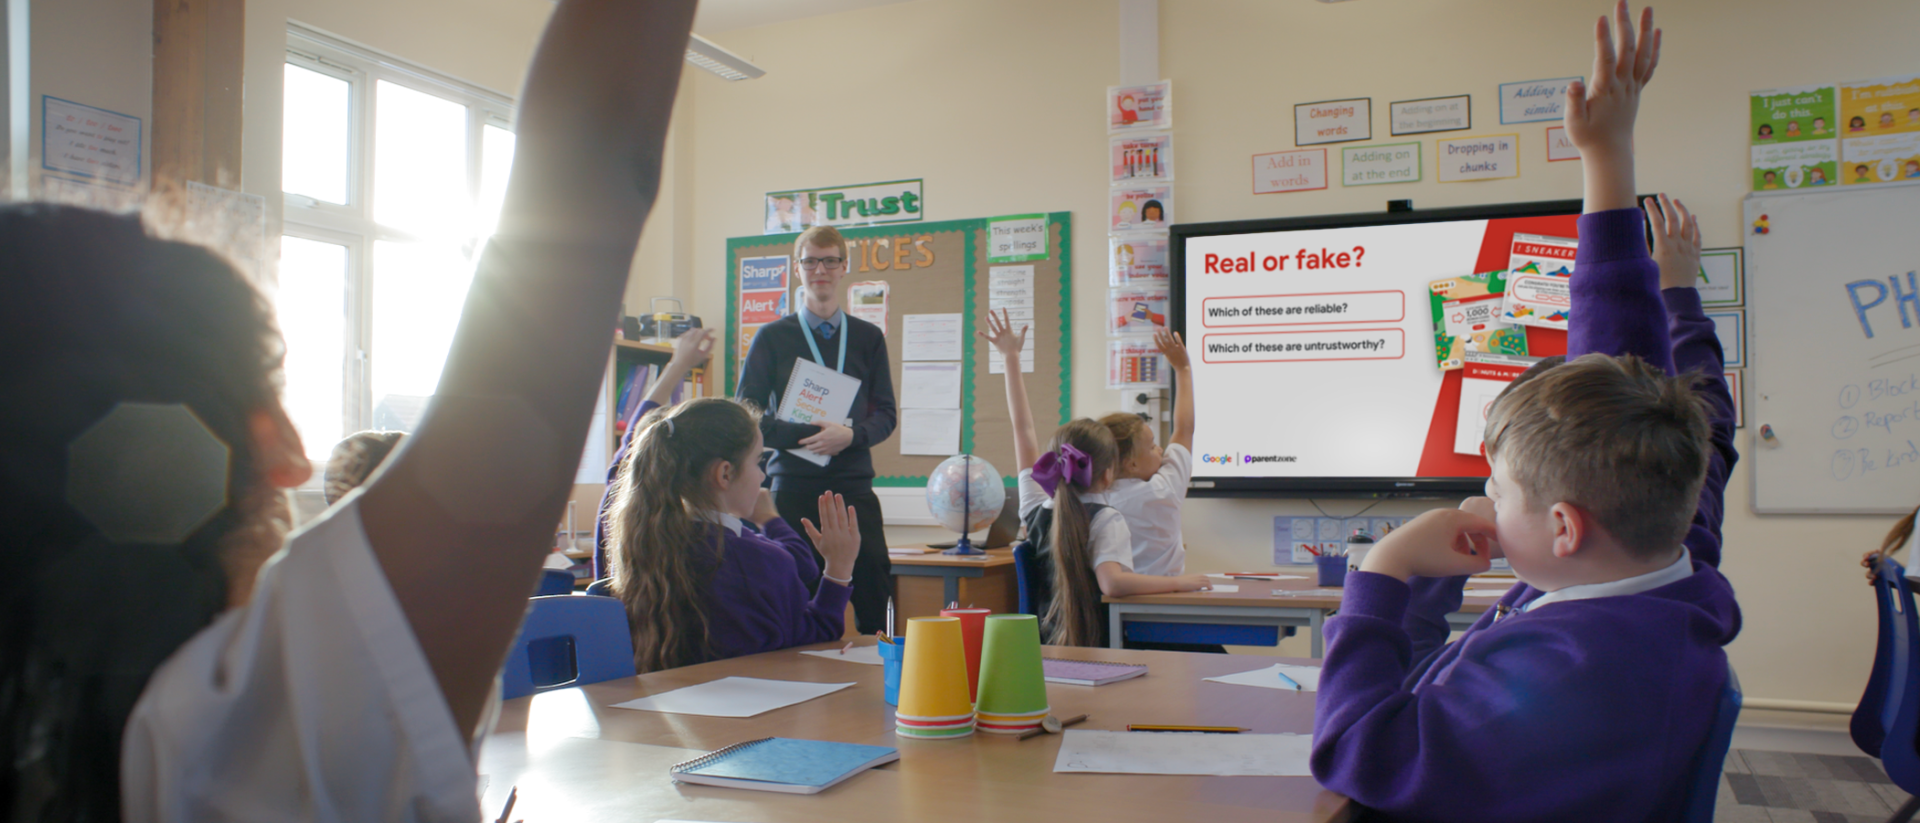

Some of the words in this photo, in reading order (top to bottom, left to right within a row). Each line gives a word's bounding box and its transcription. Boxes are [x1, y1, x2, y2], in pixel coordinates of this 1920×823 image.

[1514, 85, 1556, 99] Adding
[1763, 98, 1768, 108] I
[1771, 98, 1791, 110] just
[1795, 94, 1822, 105] can't
[1310, 105, 1354, 119] Changing
[1401, 105, 1433, 115] Adding
[1524, 103, 1560, 116] simile
[1772, 110, 1787, 120] do
[1790, 108, 1813, 118] this.
[1317, 124, 1348, 137] words
[1399, 121, 1414, 129] the
[1416, 118, 1462, 128] beginning
[1448, 140, 1494, 155] Dropping
[1498, 141, 1508, 151] in
[1267, 156, 1294, 170] Add
[1298, 156, 1311, 167] in
[1352, 150, 1392, 163] Adding
[1395, 150, 1410, 159] on
[1352, 172, 1364, 181] at
[1366, 169, 1385, 180] the
[1388, 167, 1411, 178] end
[1460, 160, 1498, 174] chunks
[1270, 174, 1309, 187] words
[819, 190, 920, 220] Trust
[992, 226, 1011, 235] This
[1013, 223, 1043, 234] week's
[847, 235, 935, 273] ICES
[1525, 245, 1575, 257] SNEAKER
[1204, 251, 1255, 274] Real
[1262, 255, 1289, 272] or
[1295, 246, 1365, 270] fake?
[743, 265, 780, 280] Sharp
[743, 299, 774, 312] Alert
[1208, 307, 1240, 317] Which
[1241, 306, 1253, 316] of
[1255, 306, 1283, 316] these
[1285, 307, 1302, 315] are
[1304, 303, 1348, 314] reliable?
[1466, 308, 1489, 317] 1,000
[1208, 343, 1240, 354] Which
[1241, 343, 1253, 352] of
[1255, 342, 1283, 352] these
[1285, 343, 1302, 351] are
[1304, 339, 1385, 351] untrustworthy?
[803, 378, 830, 396] Sharp
[799, 388, 823, 404] Alert
[795, 398, 827, 417] Secure
[791, 407, 813, 423] Kind
[1202, 453, 1232, 465] Google
